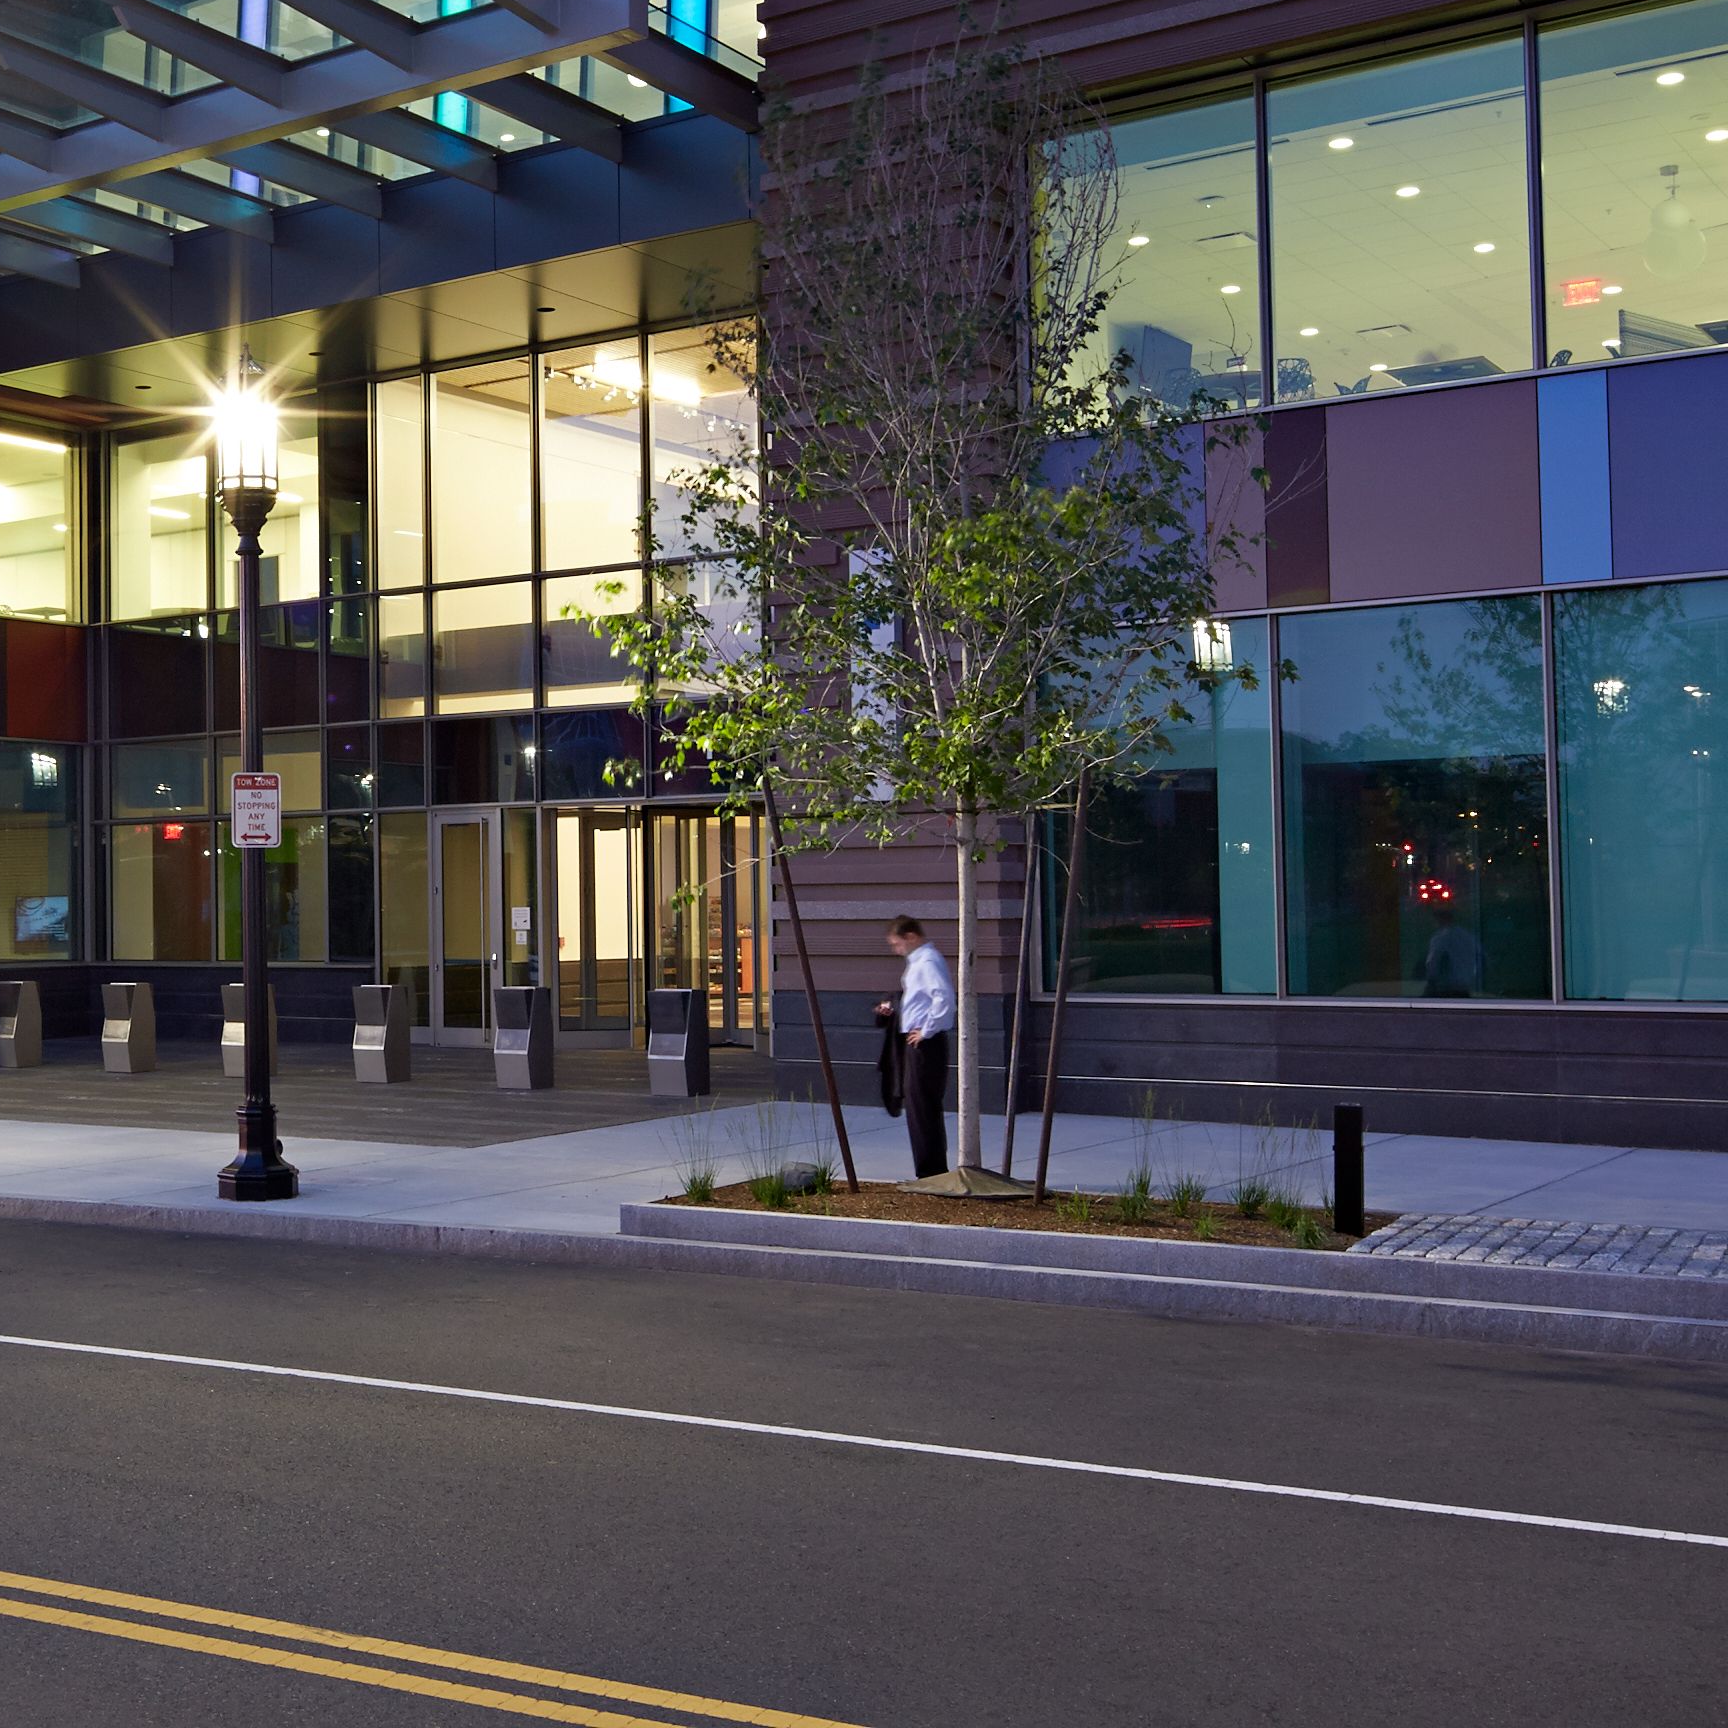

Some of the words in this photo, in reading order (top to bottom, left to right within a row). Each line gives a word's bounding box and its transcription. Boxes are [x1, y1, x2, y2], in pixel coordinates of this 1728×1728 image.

[236, 778, 252, 786] TOW
[255, 777, 277, 786] ZONE
[250, 791, 262, 799] NO
[237, 802, 276, 810] STOPPING
[248, 823, 266, 831] TIME
